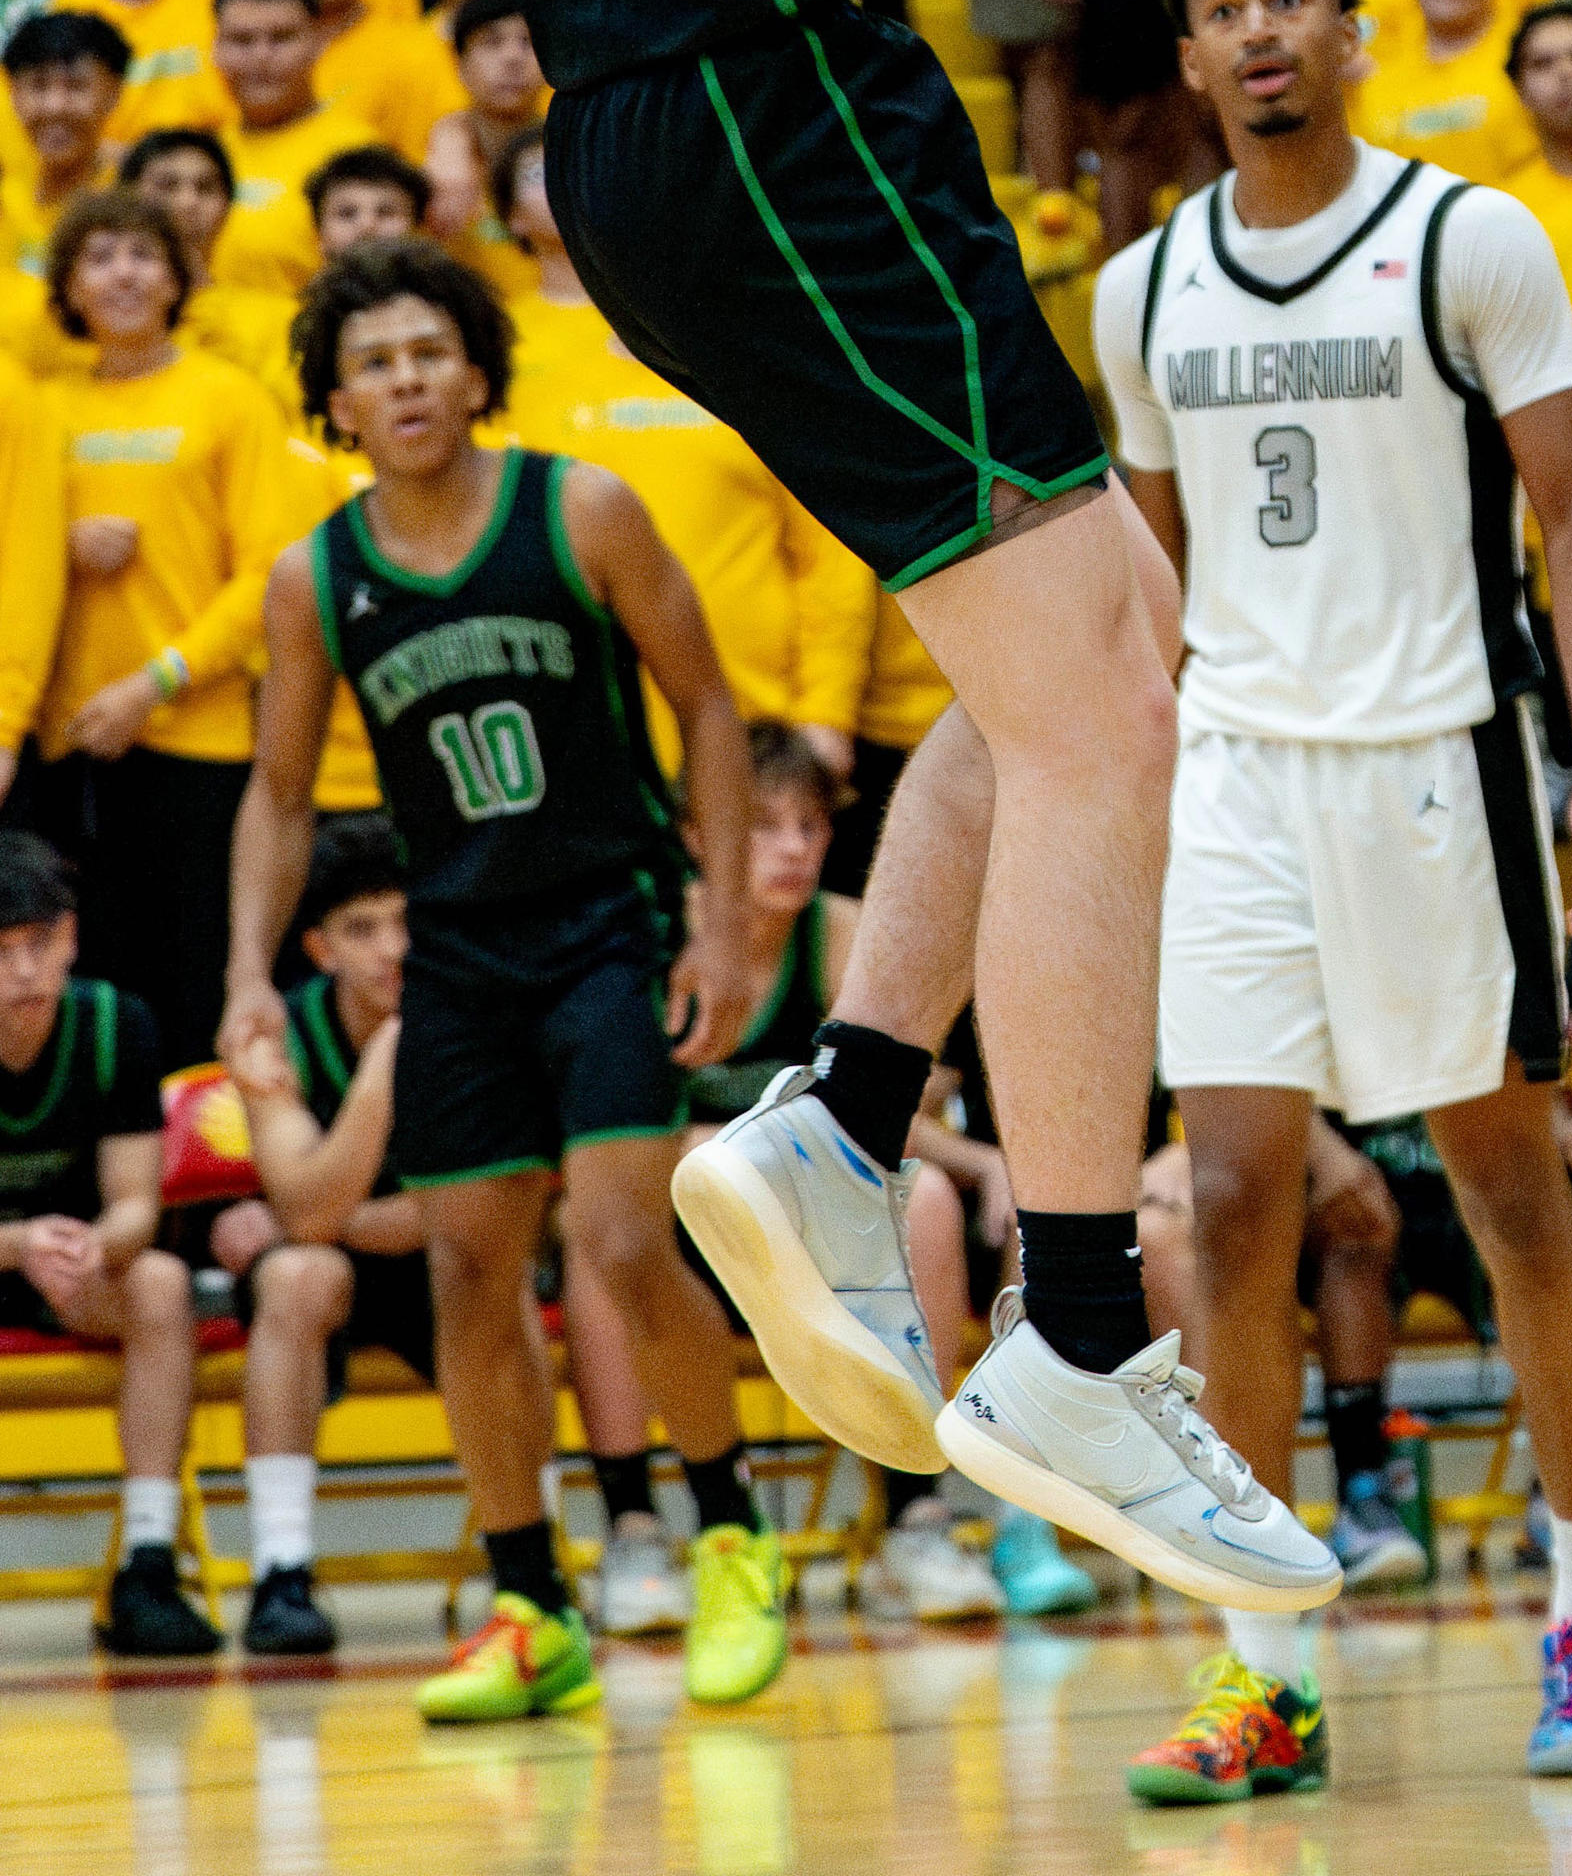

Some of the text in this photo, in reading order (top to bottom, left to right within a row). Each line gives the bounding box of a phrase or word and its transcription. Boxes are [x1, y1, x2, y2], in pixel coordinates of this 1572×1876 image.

[1167, 335, 1403, 412] MILLENNIUM
[1255, 424, 1317, 548] 3
[428, 699, 546, 823] 10
